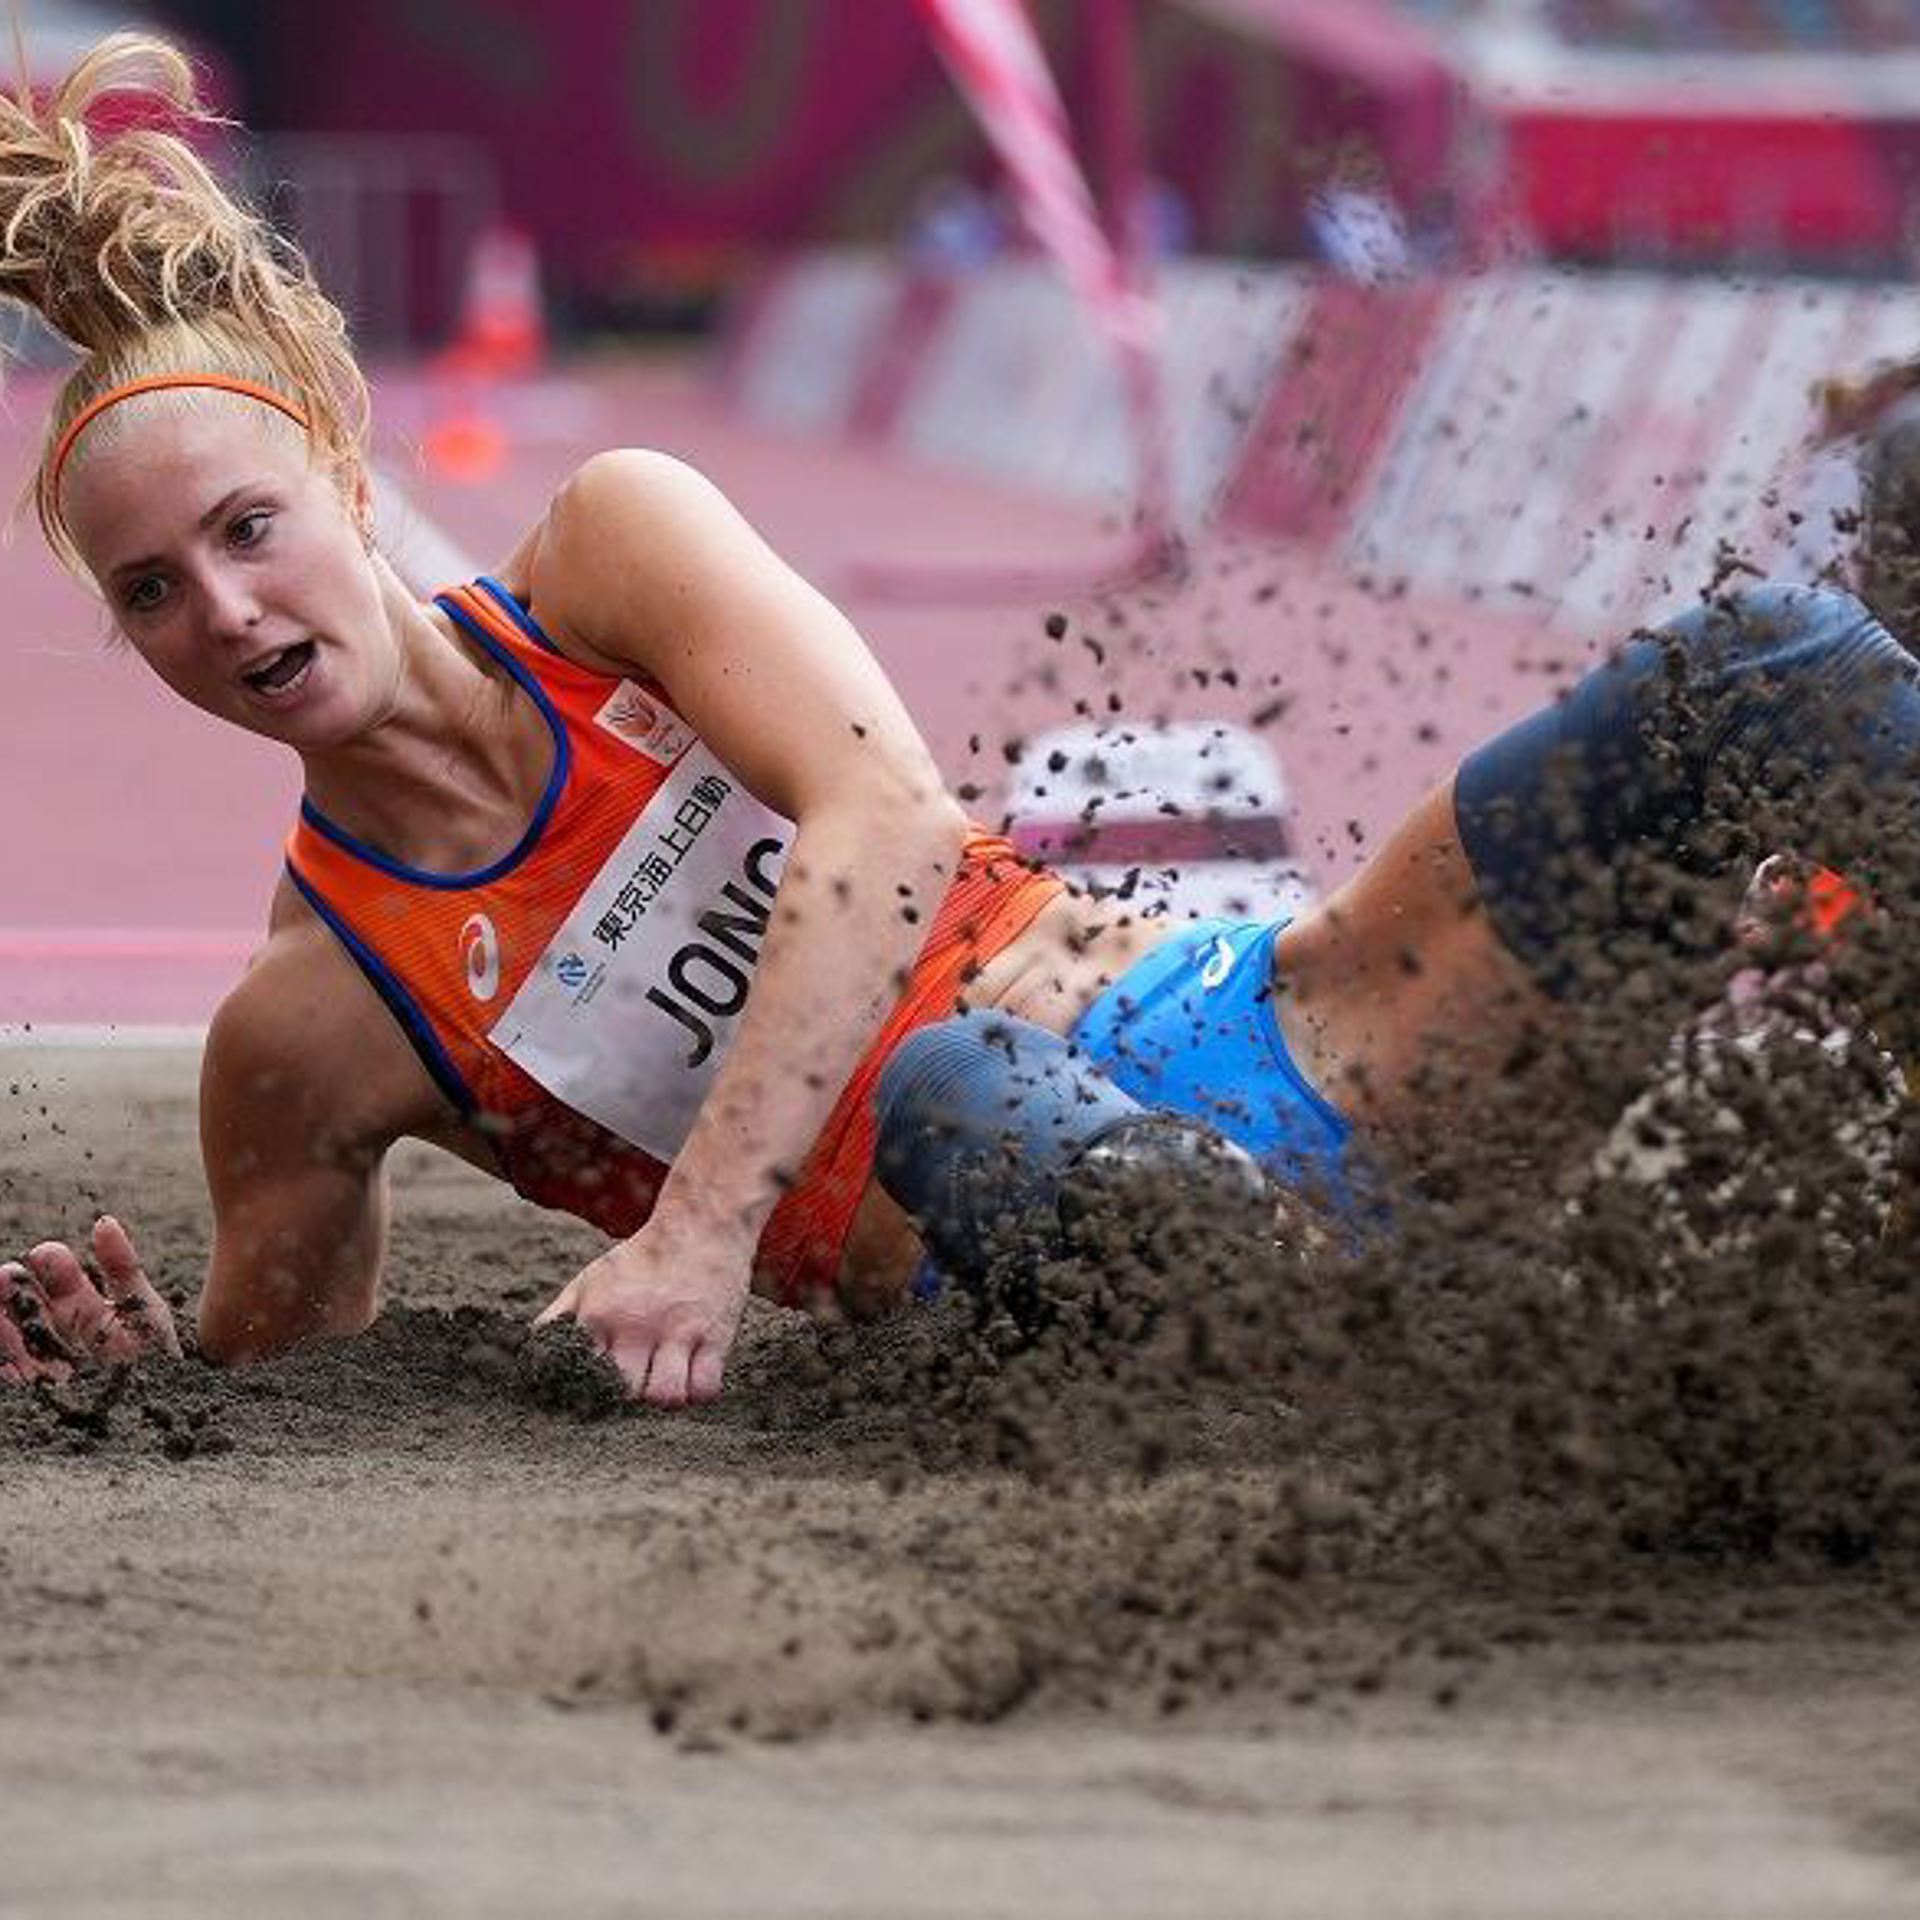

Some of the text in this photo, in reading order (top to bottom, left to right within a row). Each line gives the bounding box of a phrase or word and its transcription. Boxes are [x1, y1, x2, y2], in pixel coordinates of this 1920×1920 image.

[593, 776, 731, 951] 東京海上日動
